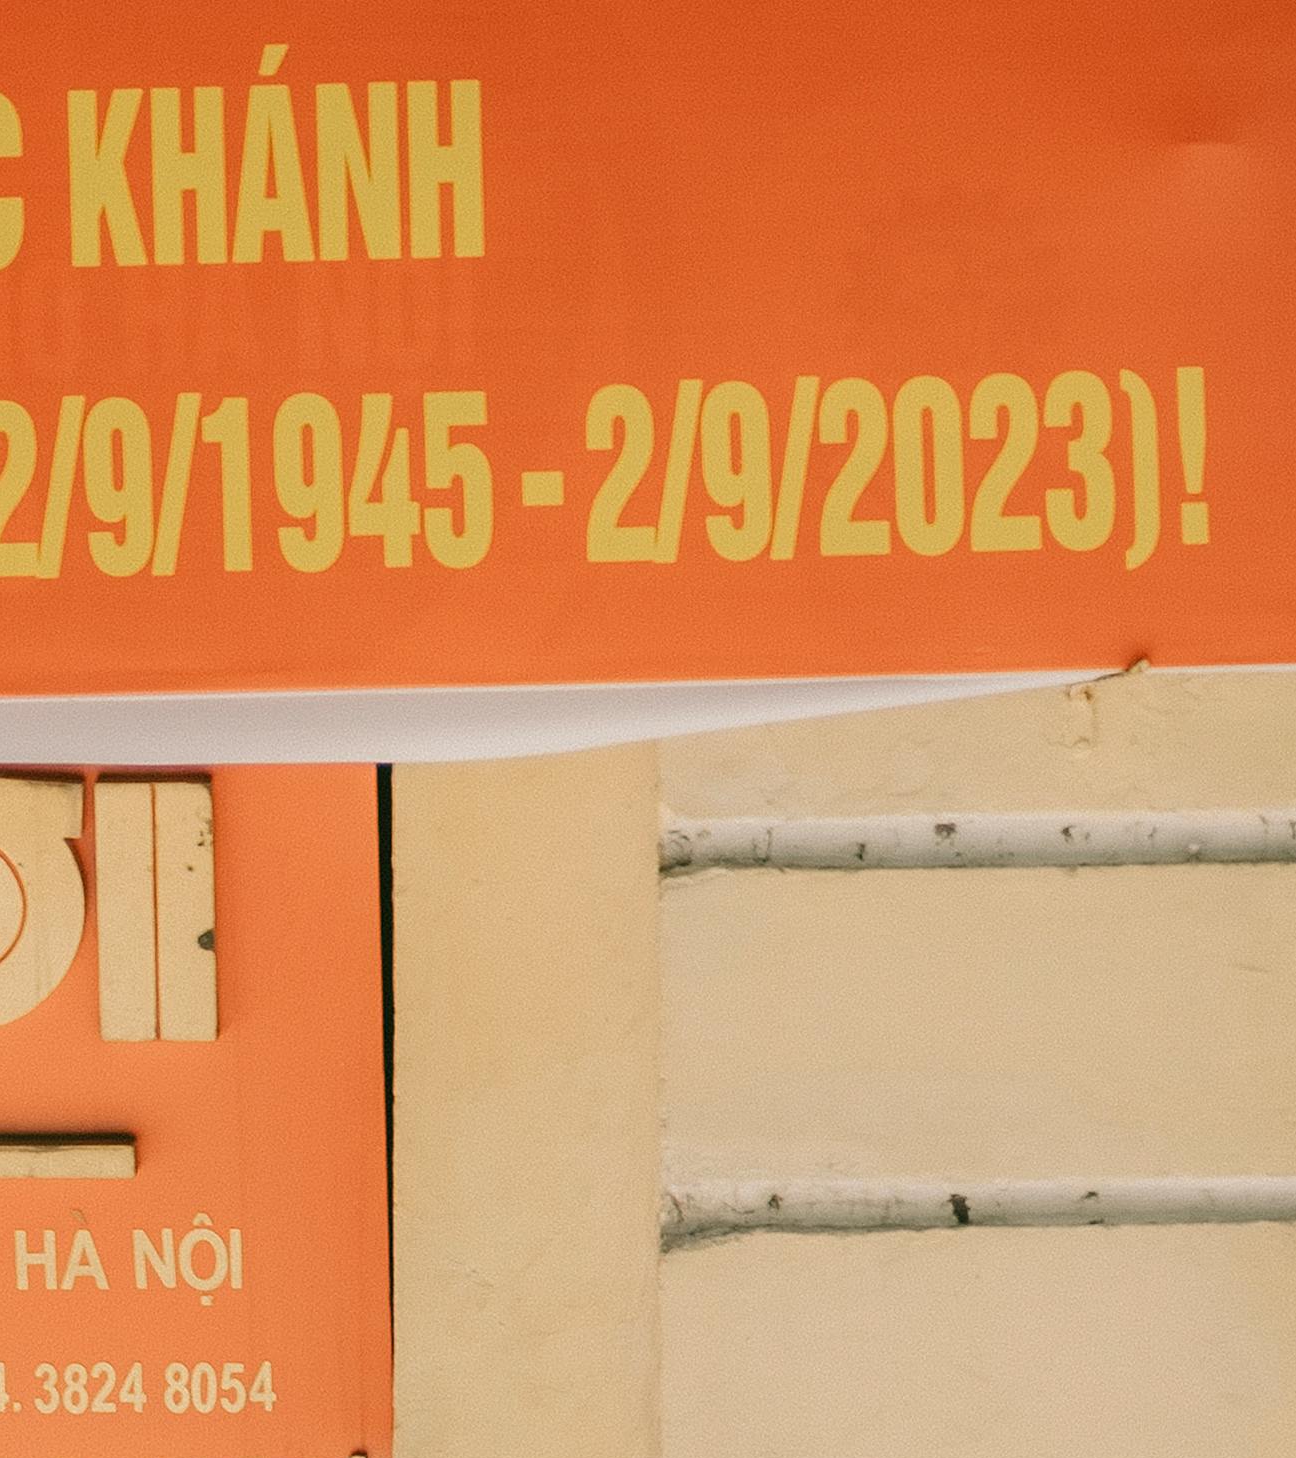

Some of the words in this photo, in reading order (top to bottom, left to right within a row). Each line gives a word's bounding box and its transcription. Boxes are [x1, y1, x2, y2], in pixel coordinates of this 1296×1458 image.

[67, 44, 484, 268] KHÁNH
[585, 366, 1209, 570] 2/9/2023)!
[132, 1212, 243, 1307] NỘI
[33, 1361, 148, 1416] 3824
[162, 1361, 277, 1415] 8054
